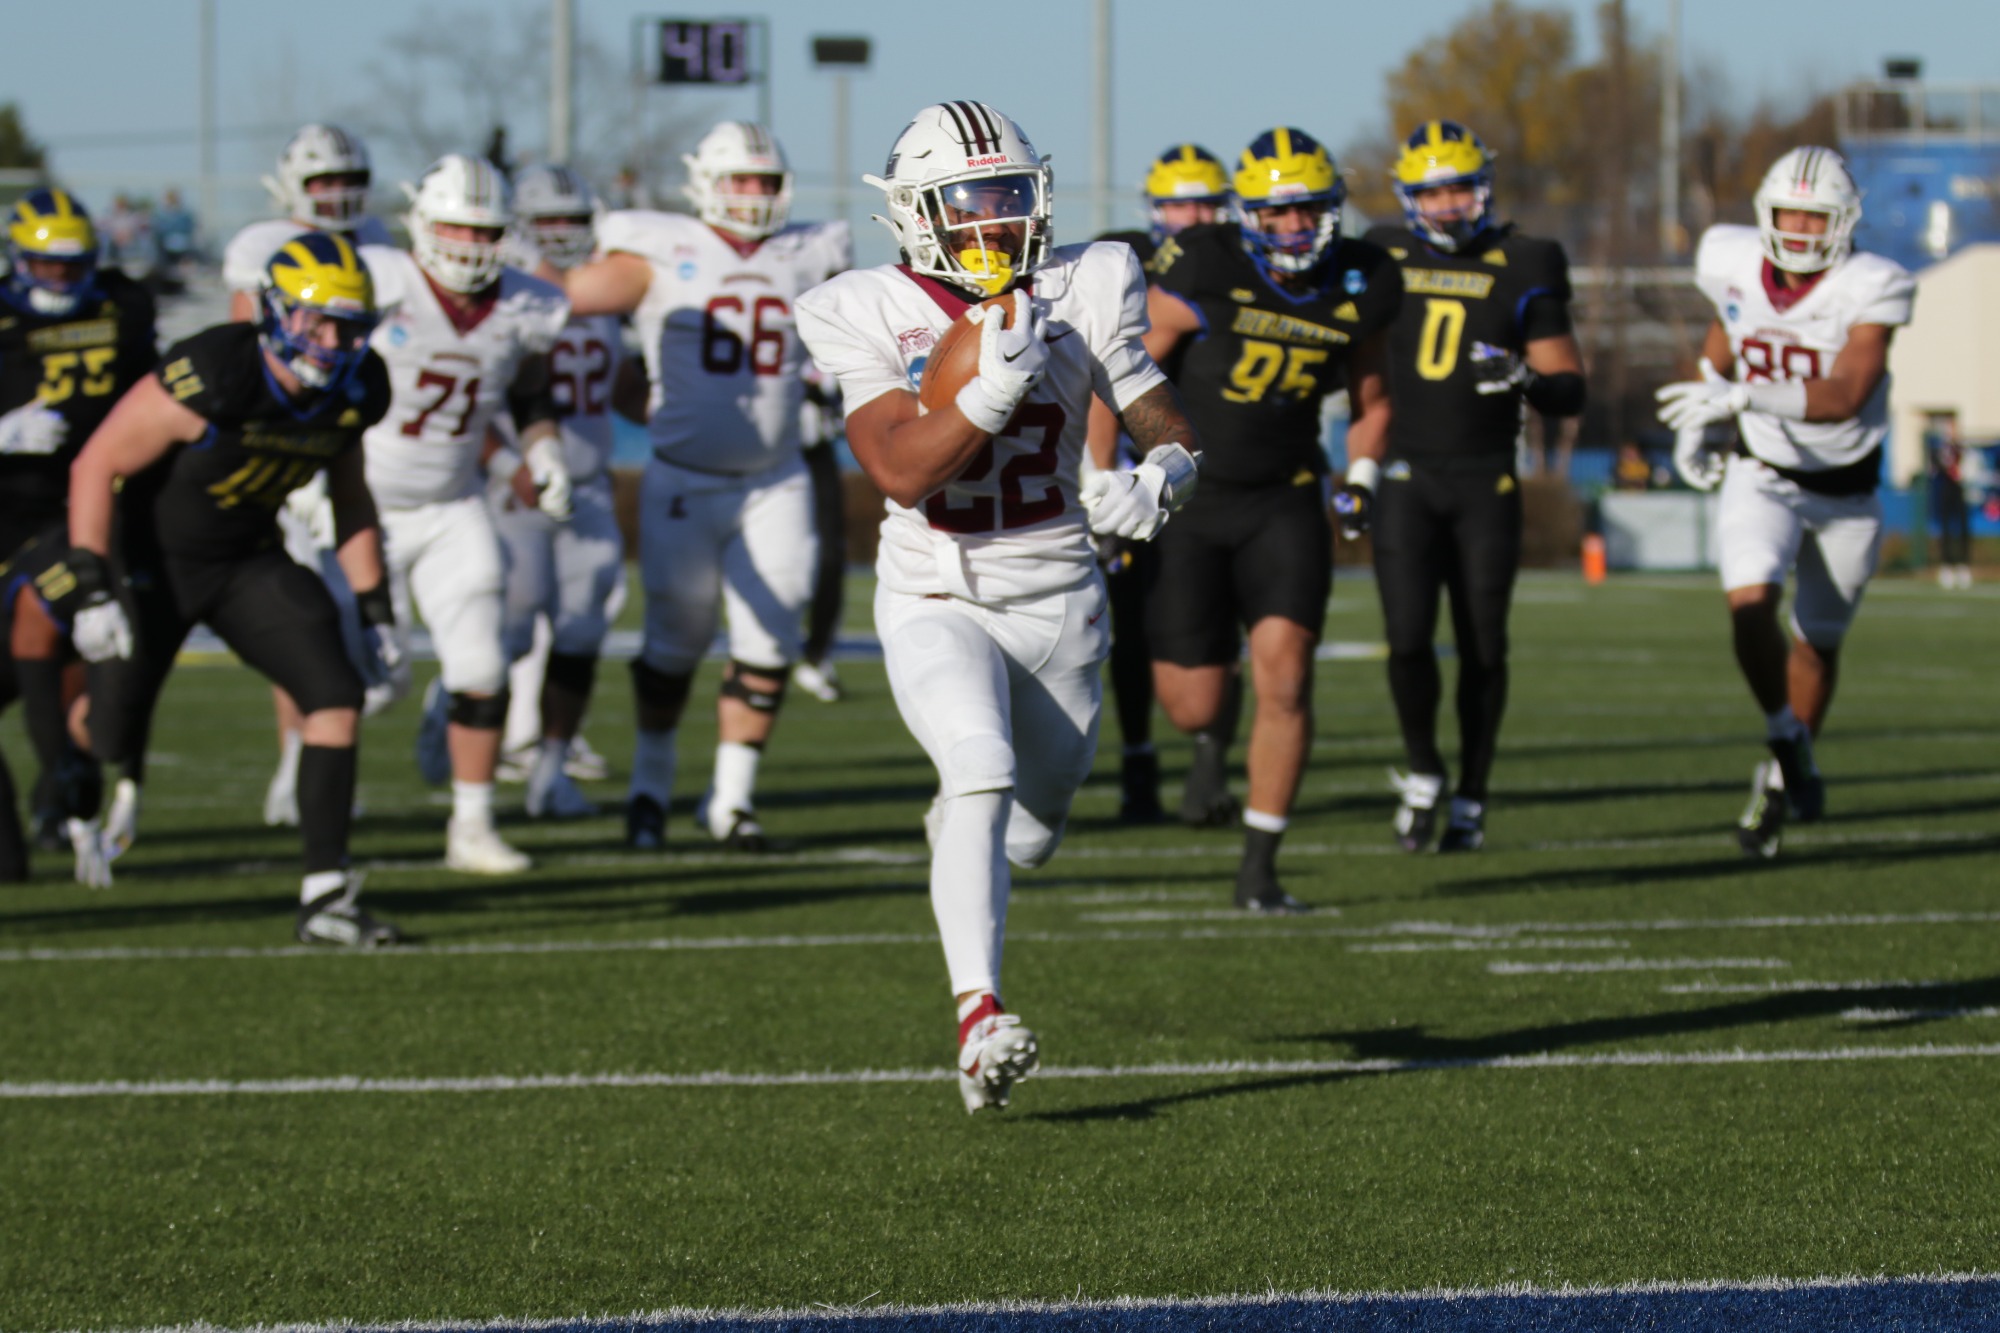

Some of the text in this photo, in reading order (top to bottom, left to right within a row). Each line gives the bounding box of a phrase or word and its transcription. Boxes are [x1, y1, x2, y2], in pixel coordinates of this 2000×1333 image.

[663, 23, 744, 83] 40
[967, 155, 1007, 168] Riddell
[702, 295, 789, 376] 66
[1416, 298, 1467, 381] 0
[36, 346, 117, 406] 55
[400, 368, 482, 437] 71
[549, 338, 611, 416] 62
[1220, 339, 1329, 403] 95
